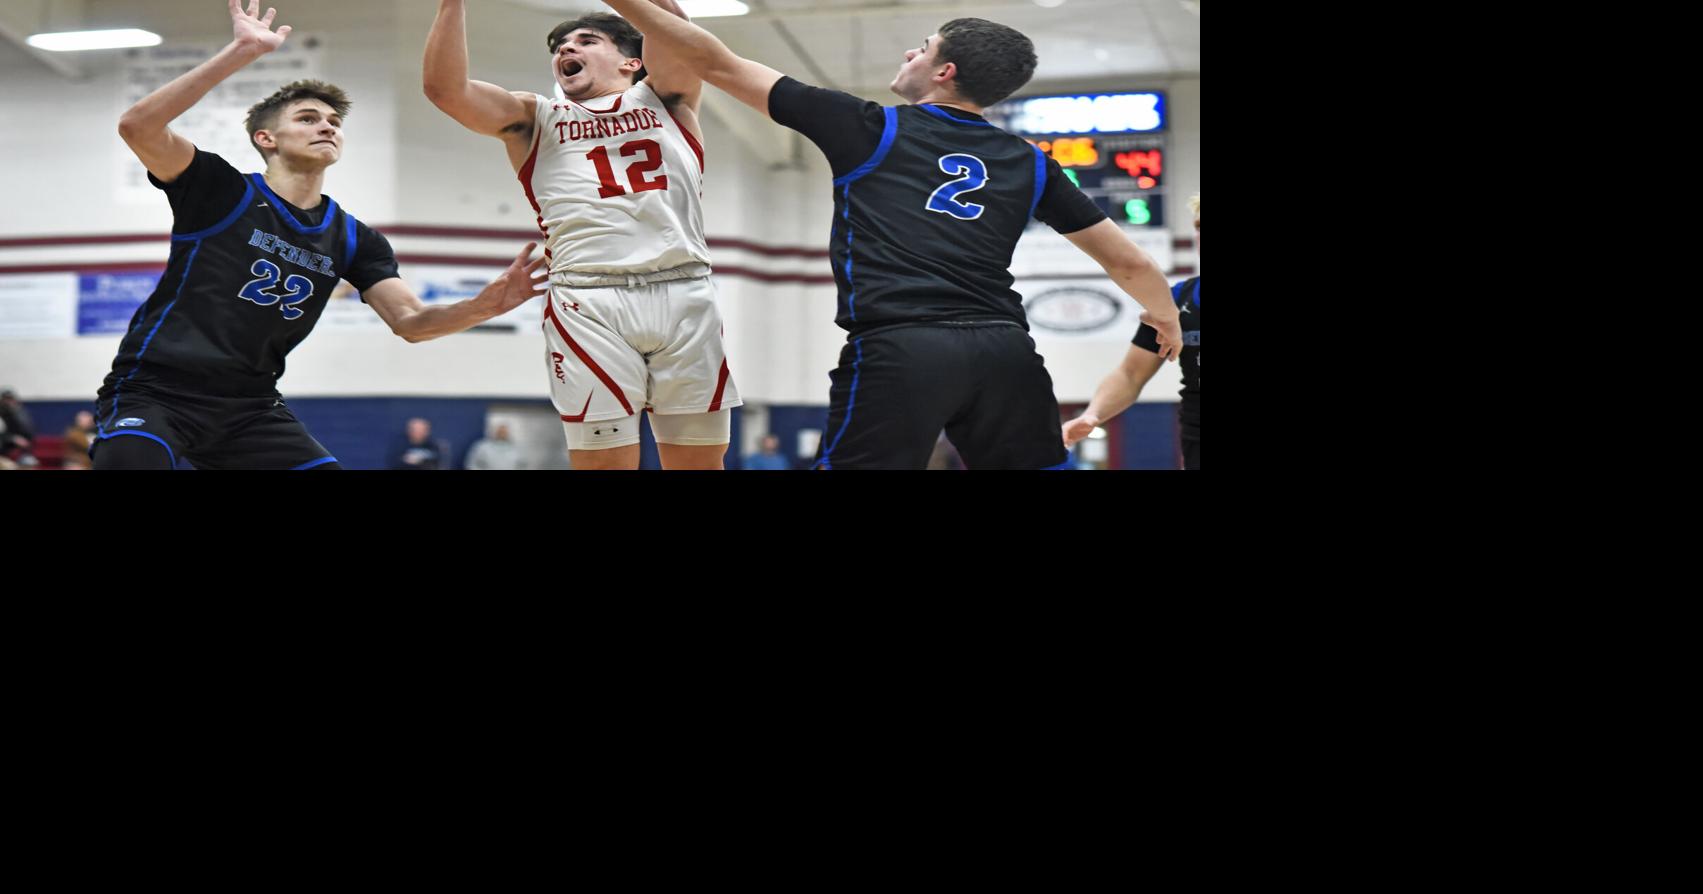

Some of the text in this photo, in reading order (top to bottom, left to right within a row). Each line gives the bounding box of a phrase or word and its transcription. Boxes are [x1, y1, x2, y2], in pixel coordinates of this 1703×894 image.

[585, 138, 669, 200] 12
[924, 152, 990, 221] 2
[1114, 149, 1163, 177] 44
[237, 258, 314, 320] 22
